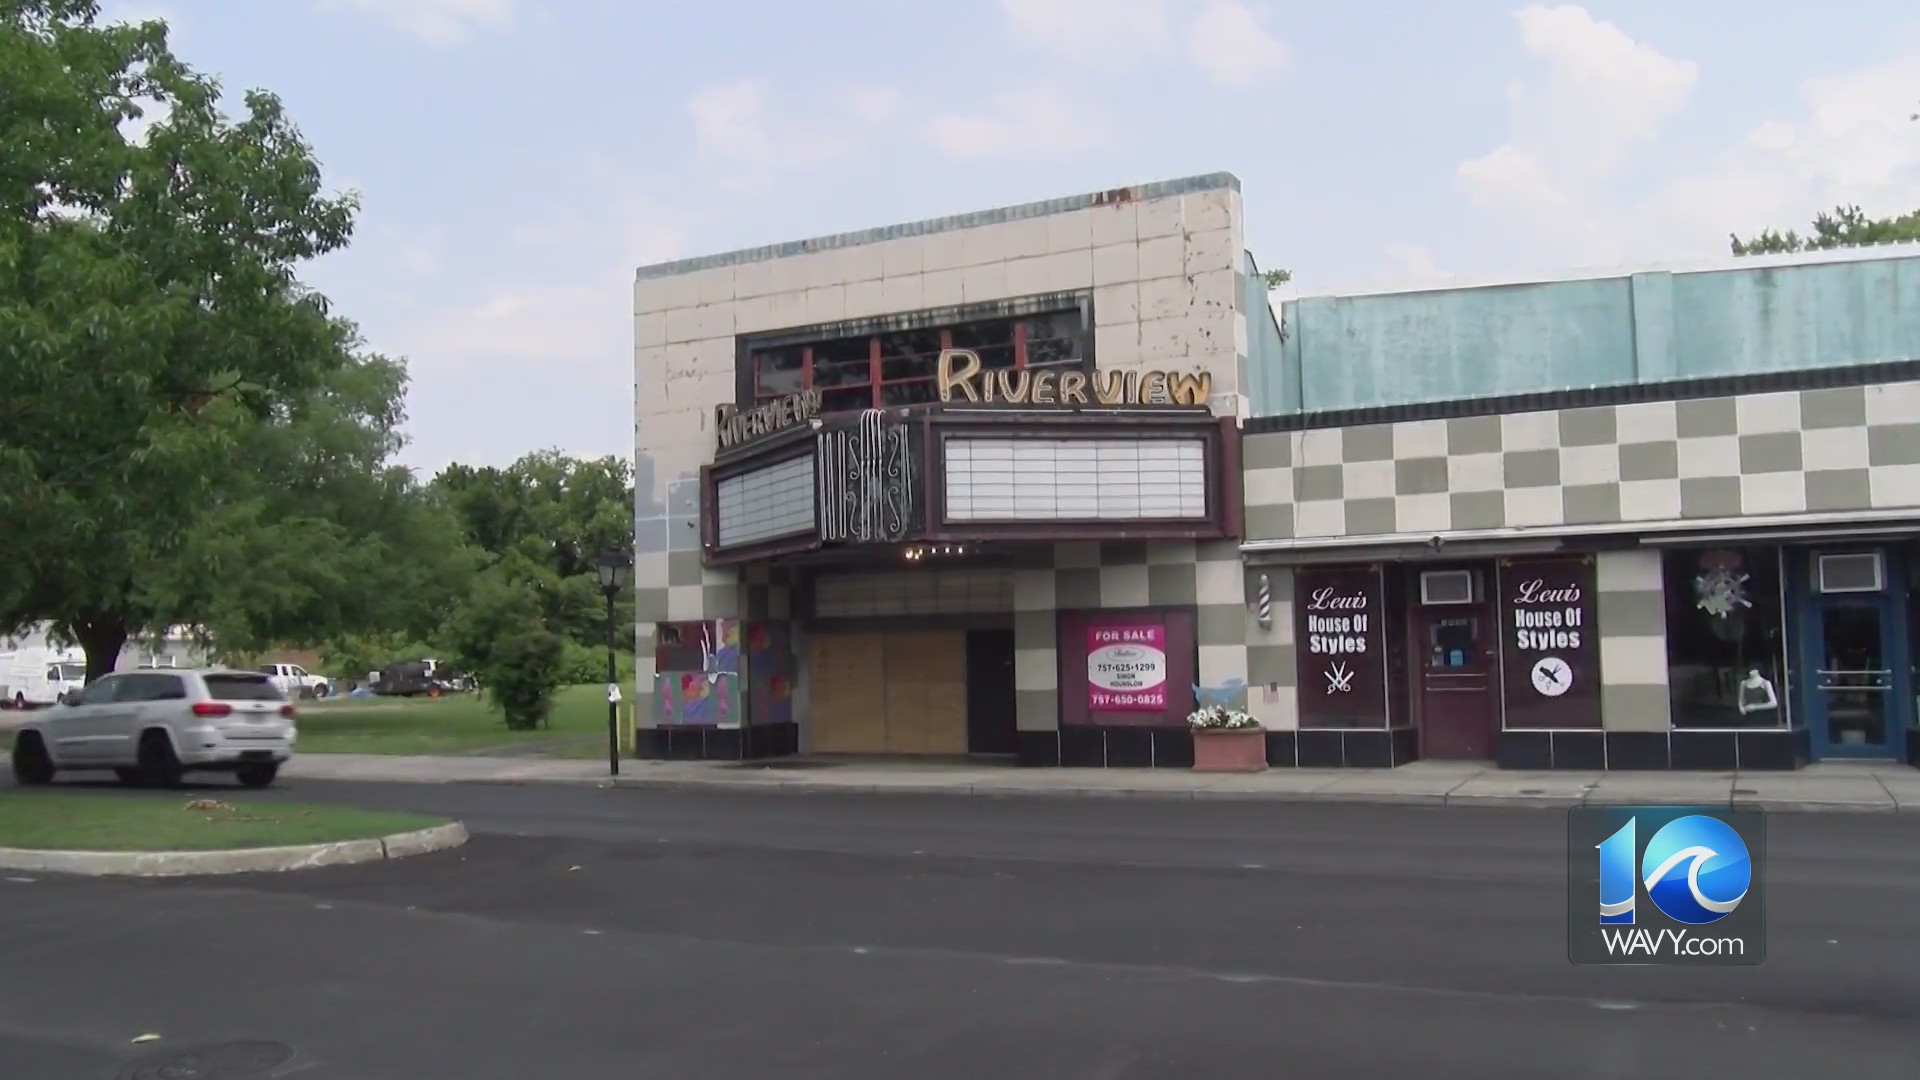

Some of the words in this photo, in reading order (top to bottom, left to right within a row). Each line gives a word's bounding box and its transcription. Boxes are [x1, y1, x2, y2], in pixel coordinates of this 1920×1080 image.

[937, 348, 1212, 406] RIVERVIEW
[1307, 586, 1368, 611] Lewis
[1513, 578, 1581, 604] Lewis
[1307, 614, 1351, 633] House
[1353, 614, 1368, 632] Of
[1515, 608, 1563, 628] House
[1565, 607, 1582, 627] Of
[1095, 630, 1119, 641] FOR
[1123, 629, 1155, 641] SALE
[1309, 633, 1367, 655] Styles
[1516, 629, 1581, 651] Styles
